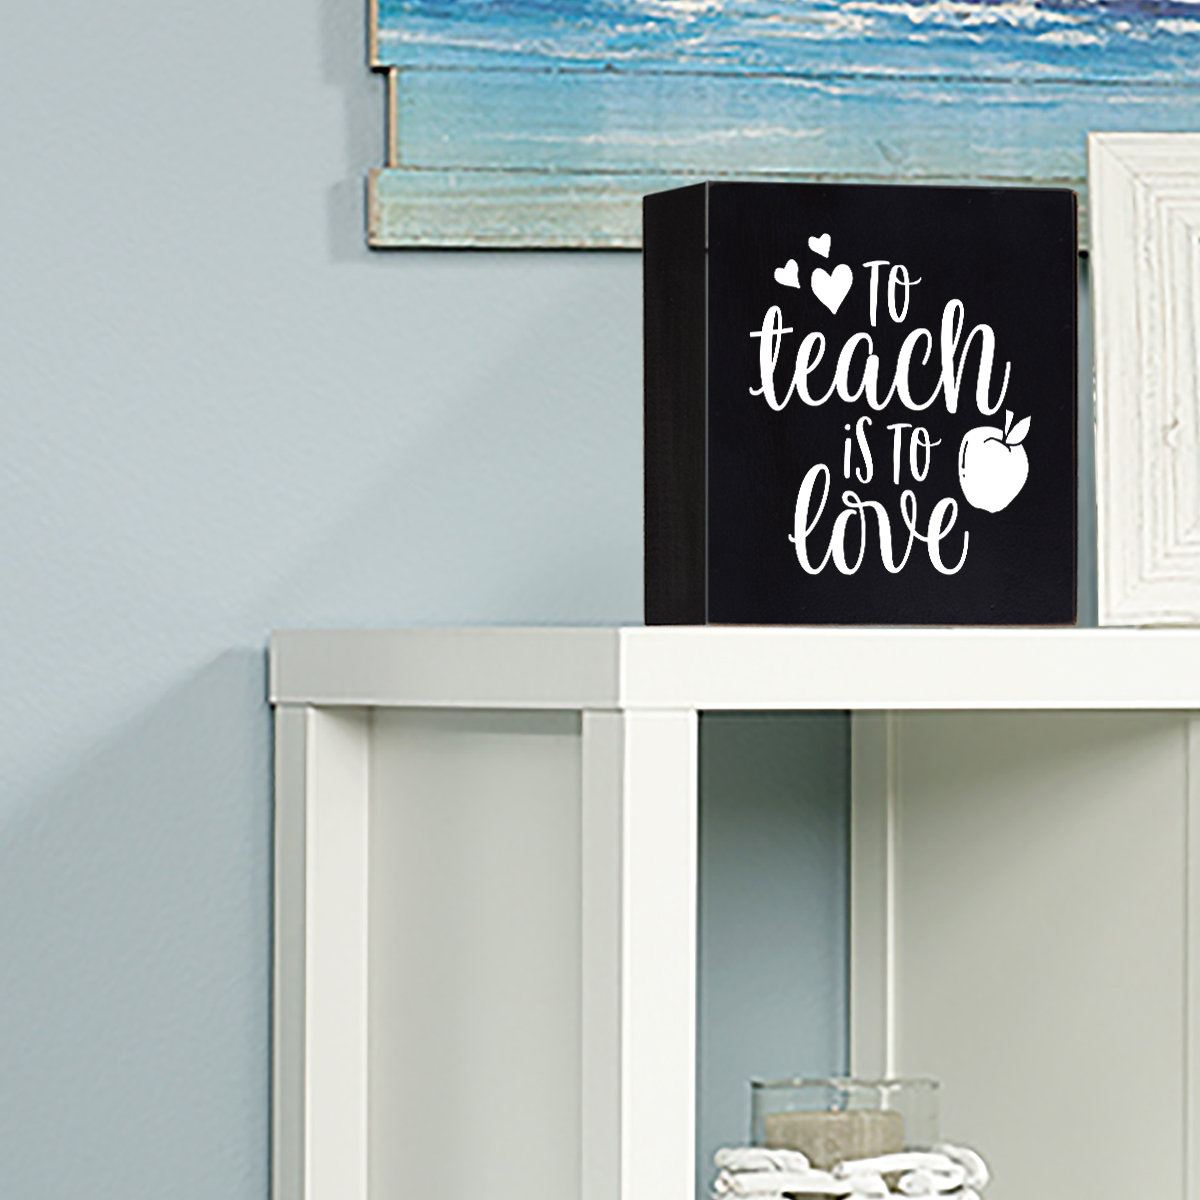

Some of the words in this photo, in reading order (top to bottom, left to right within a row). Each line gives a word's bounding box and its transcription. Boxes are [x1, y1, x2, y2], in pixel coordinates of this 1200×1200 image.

[862, 260, 922, 327] TO
[748, 299, 1012, 416] teach
[886, 423, 942, 485] TO
[788, 463, 970, 576] love
